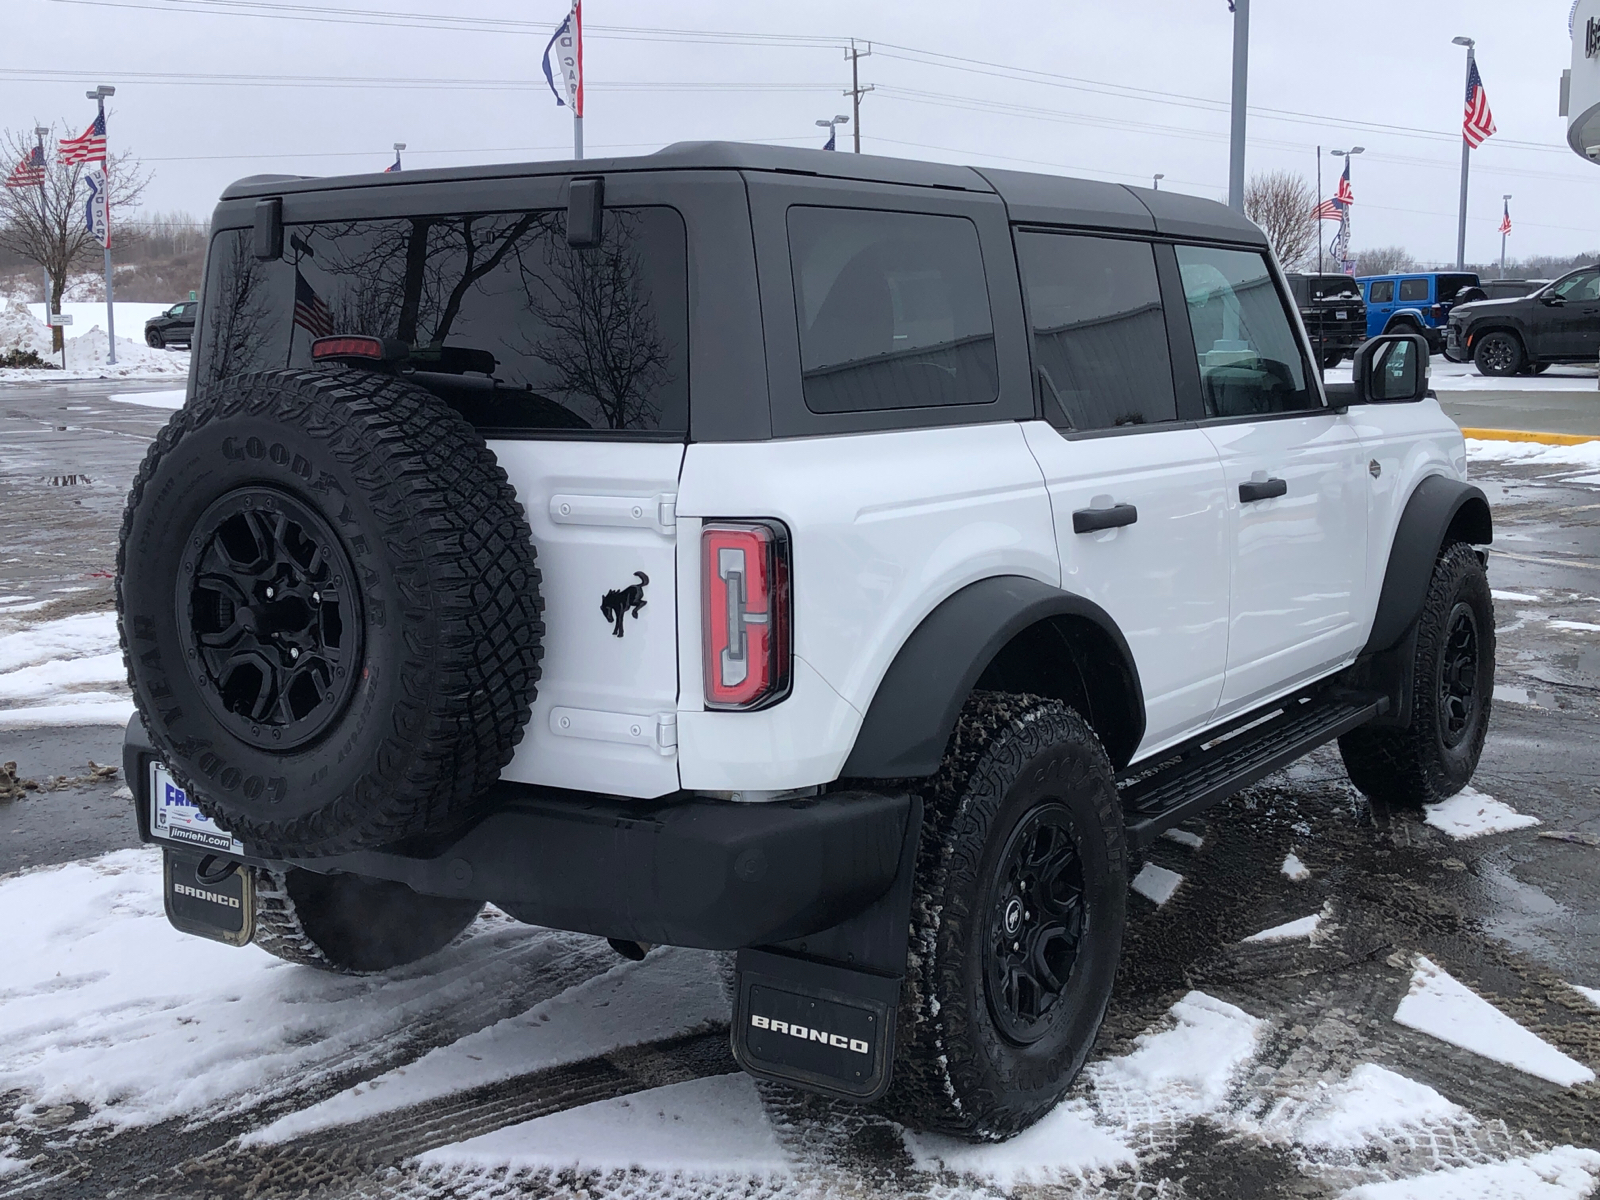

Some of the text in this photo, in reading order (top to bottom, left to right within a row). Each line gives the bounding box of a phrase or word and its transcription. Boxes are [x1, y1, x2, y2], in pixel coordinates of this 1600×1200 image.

[222, 436, 386, 628] GOODYEAR
[133, 615, 288, 804] GOODYEAR
[170, 828, 230, 848] jimriehl.com
[174, 882, 240, 909] BRONCO
[751, 1014, 869, 1054] BRONCO
